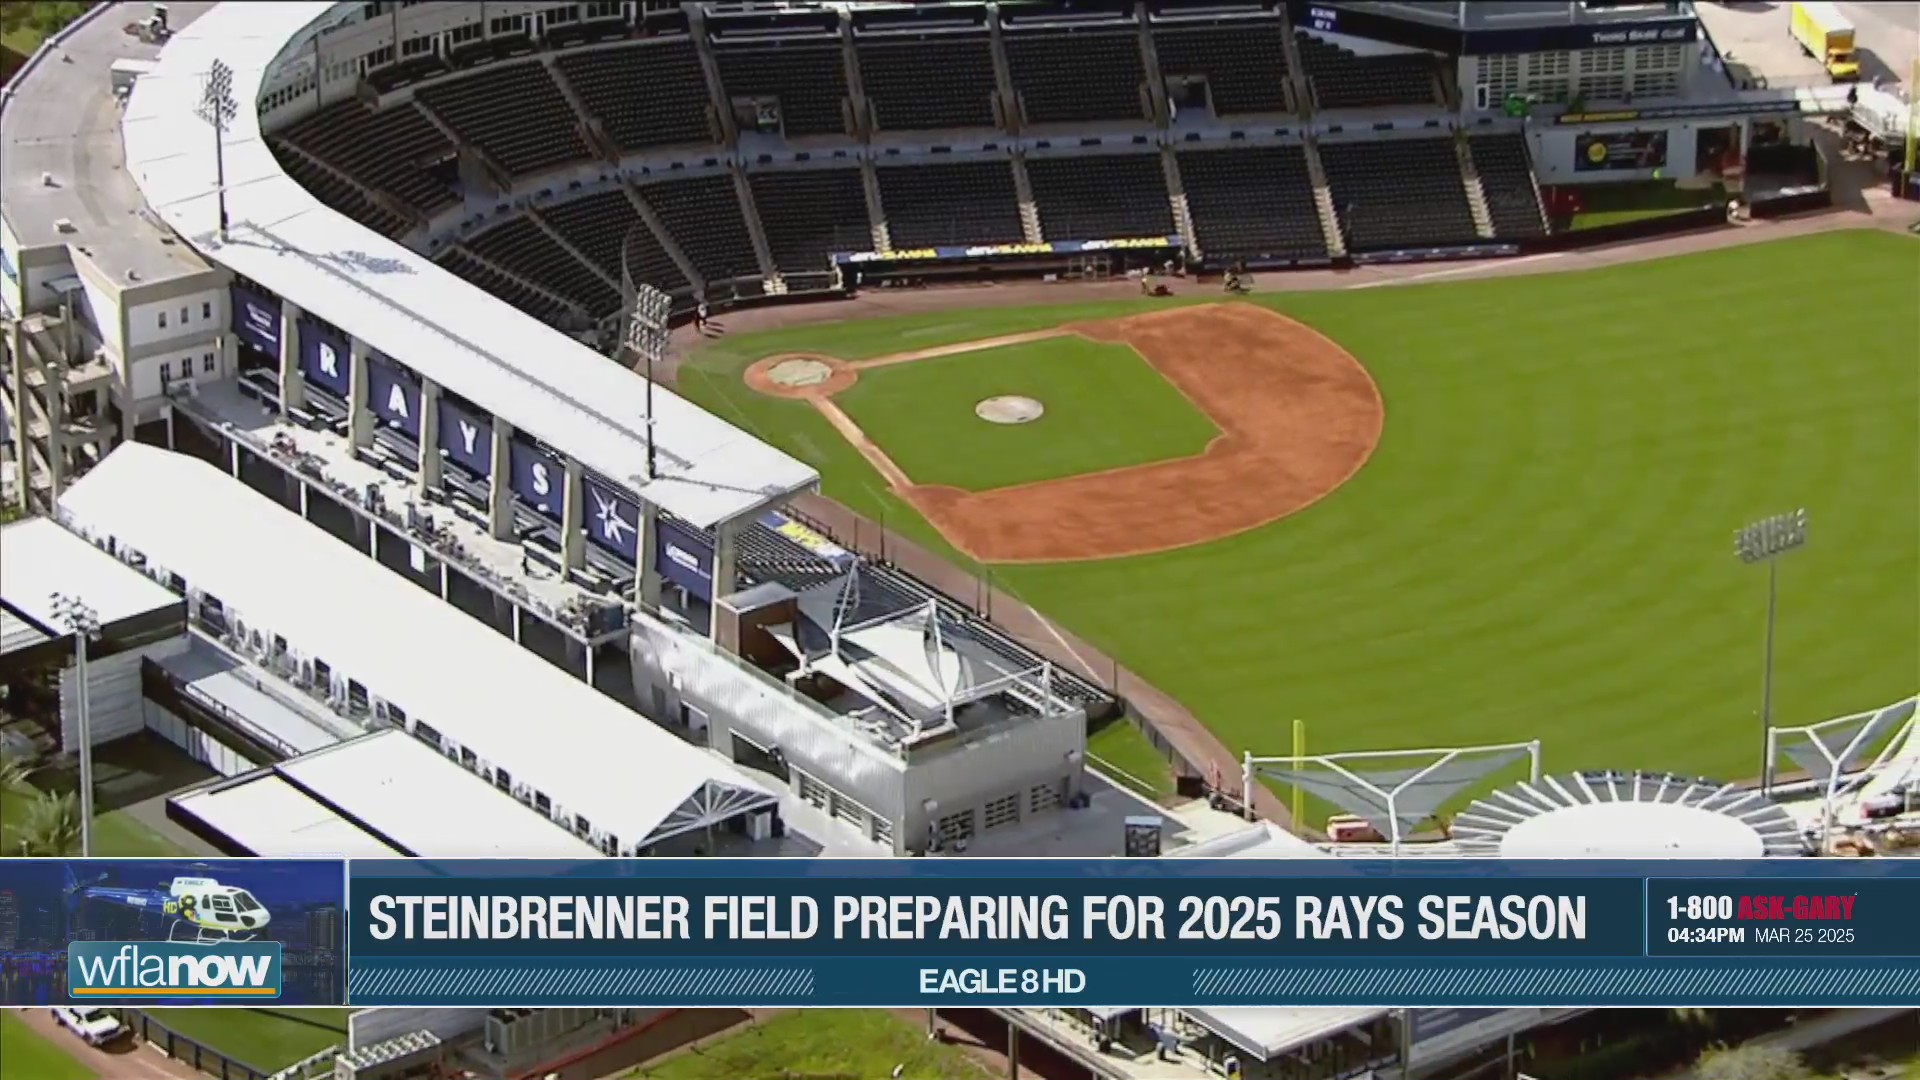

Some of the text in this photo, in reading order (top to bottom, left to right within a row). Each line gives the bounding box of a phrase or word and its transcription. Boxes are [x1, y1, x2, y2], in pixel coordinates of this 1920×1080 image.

[320, 343, 337, 378] R
[388, 384, 408, 419] A
[460, 420, 476, 454] Y
[532, 462, 549, 495] S
